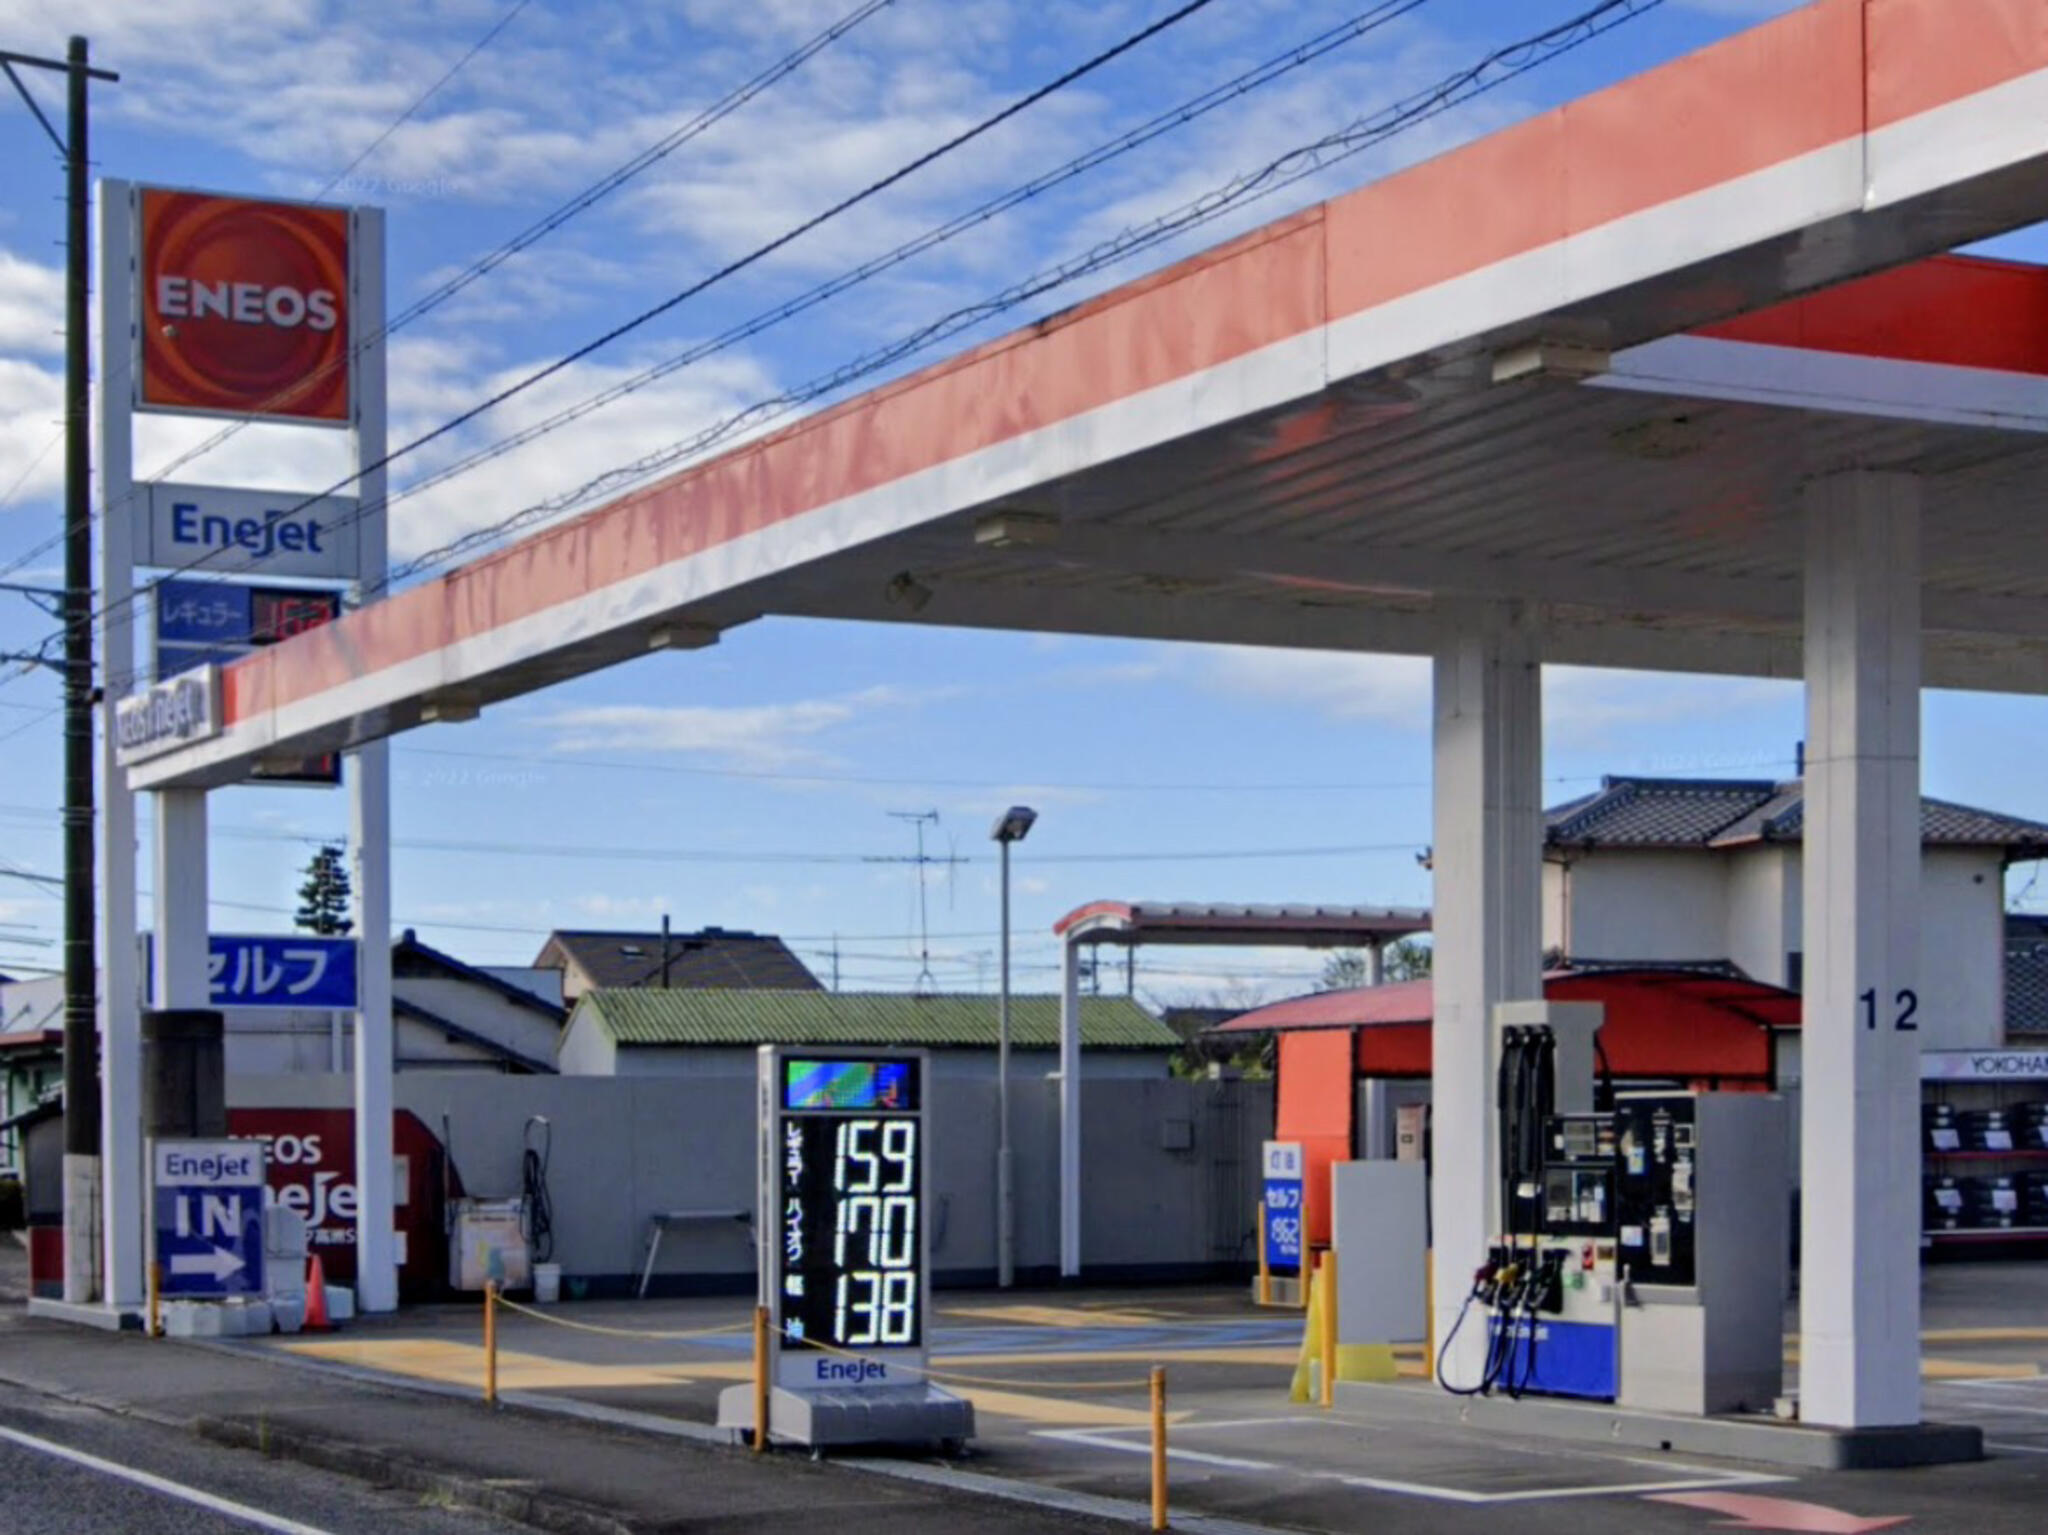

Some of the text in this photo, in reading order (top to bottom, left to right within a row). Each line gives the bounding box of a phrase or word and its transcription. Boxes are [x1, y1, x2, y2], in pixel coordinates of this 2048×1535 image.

[157, 275, 337, 332] ENEOS
[162, 599, 242, 627] レギュラー
[834, 1120, 916, 1193] 159
[175, 1194, 241, 1238] IN
[785, 1197, 804, 1262] ハイオク
[834, 1196, 916, 1269] 170
[834, 1271, 916, 1345] 138
